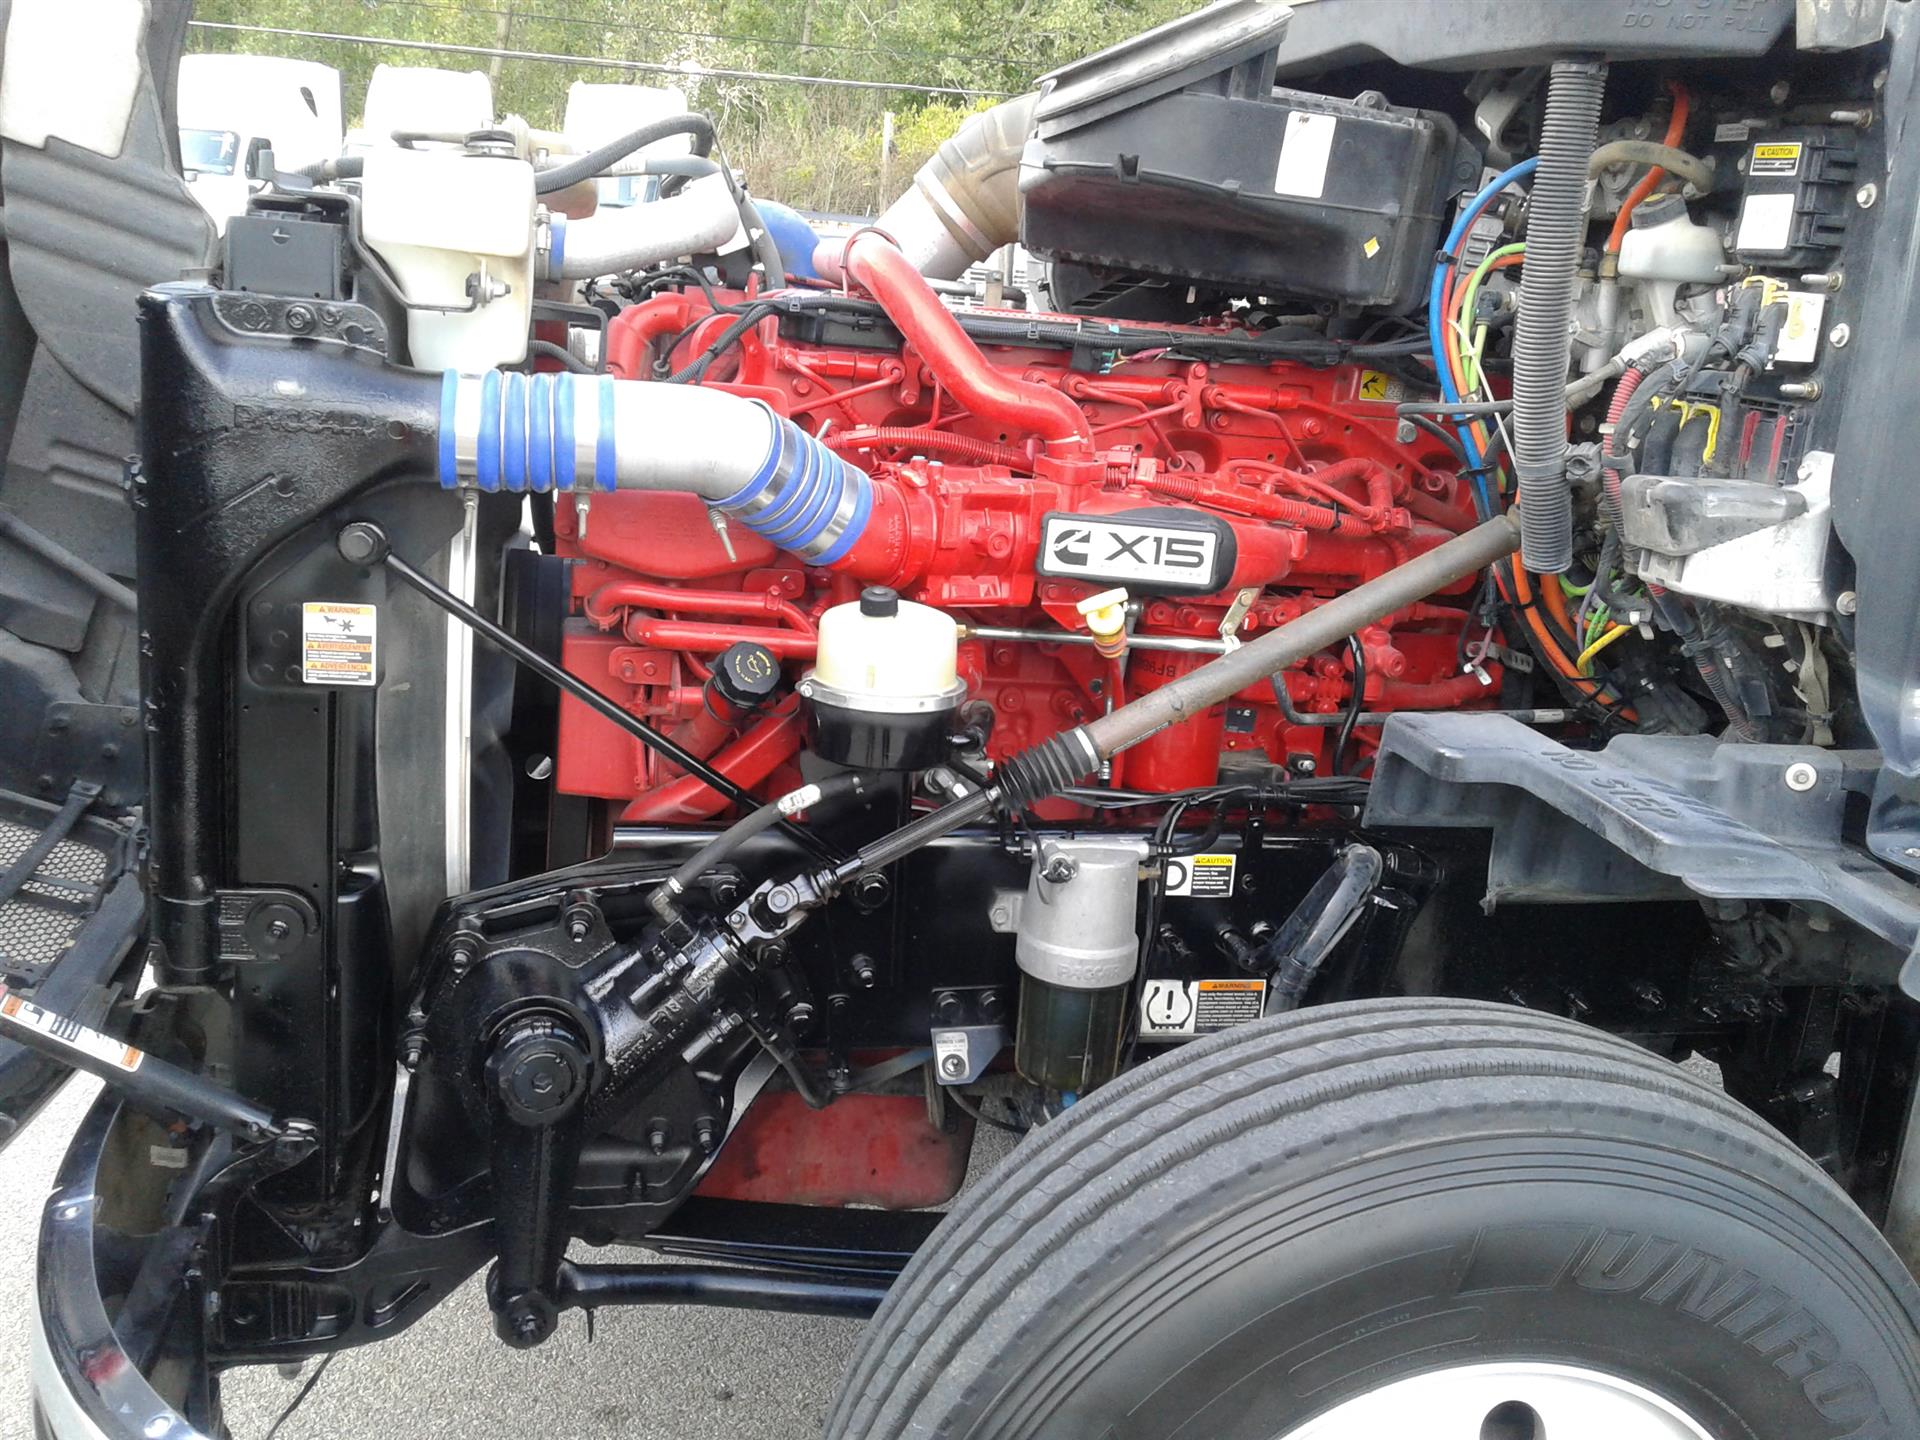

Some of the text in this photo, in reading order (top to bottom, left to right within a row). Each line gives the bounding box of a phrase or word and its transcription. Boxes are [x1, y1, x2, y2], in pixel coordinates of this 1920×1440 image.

[1624, 14, 1654, 28] DO
[1666, 15, 1712, 30] NOT
[1767, 148, 1794, 156] CAUTION
[1104, 531, 1205, 569] X15
[327, 606, 361, 615] WARNING
[1541, 751, 1599, 771] NO
[1591, 777, 1681, 819] STEP
[1572, 1229, 1892, 1440] UNIRO
